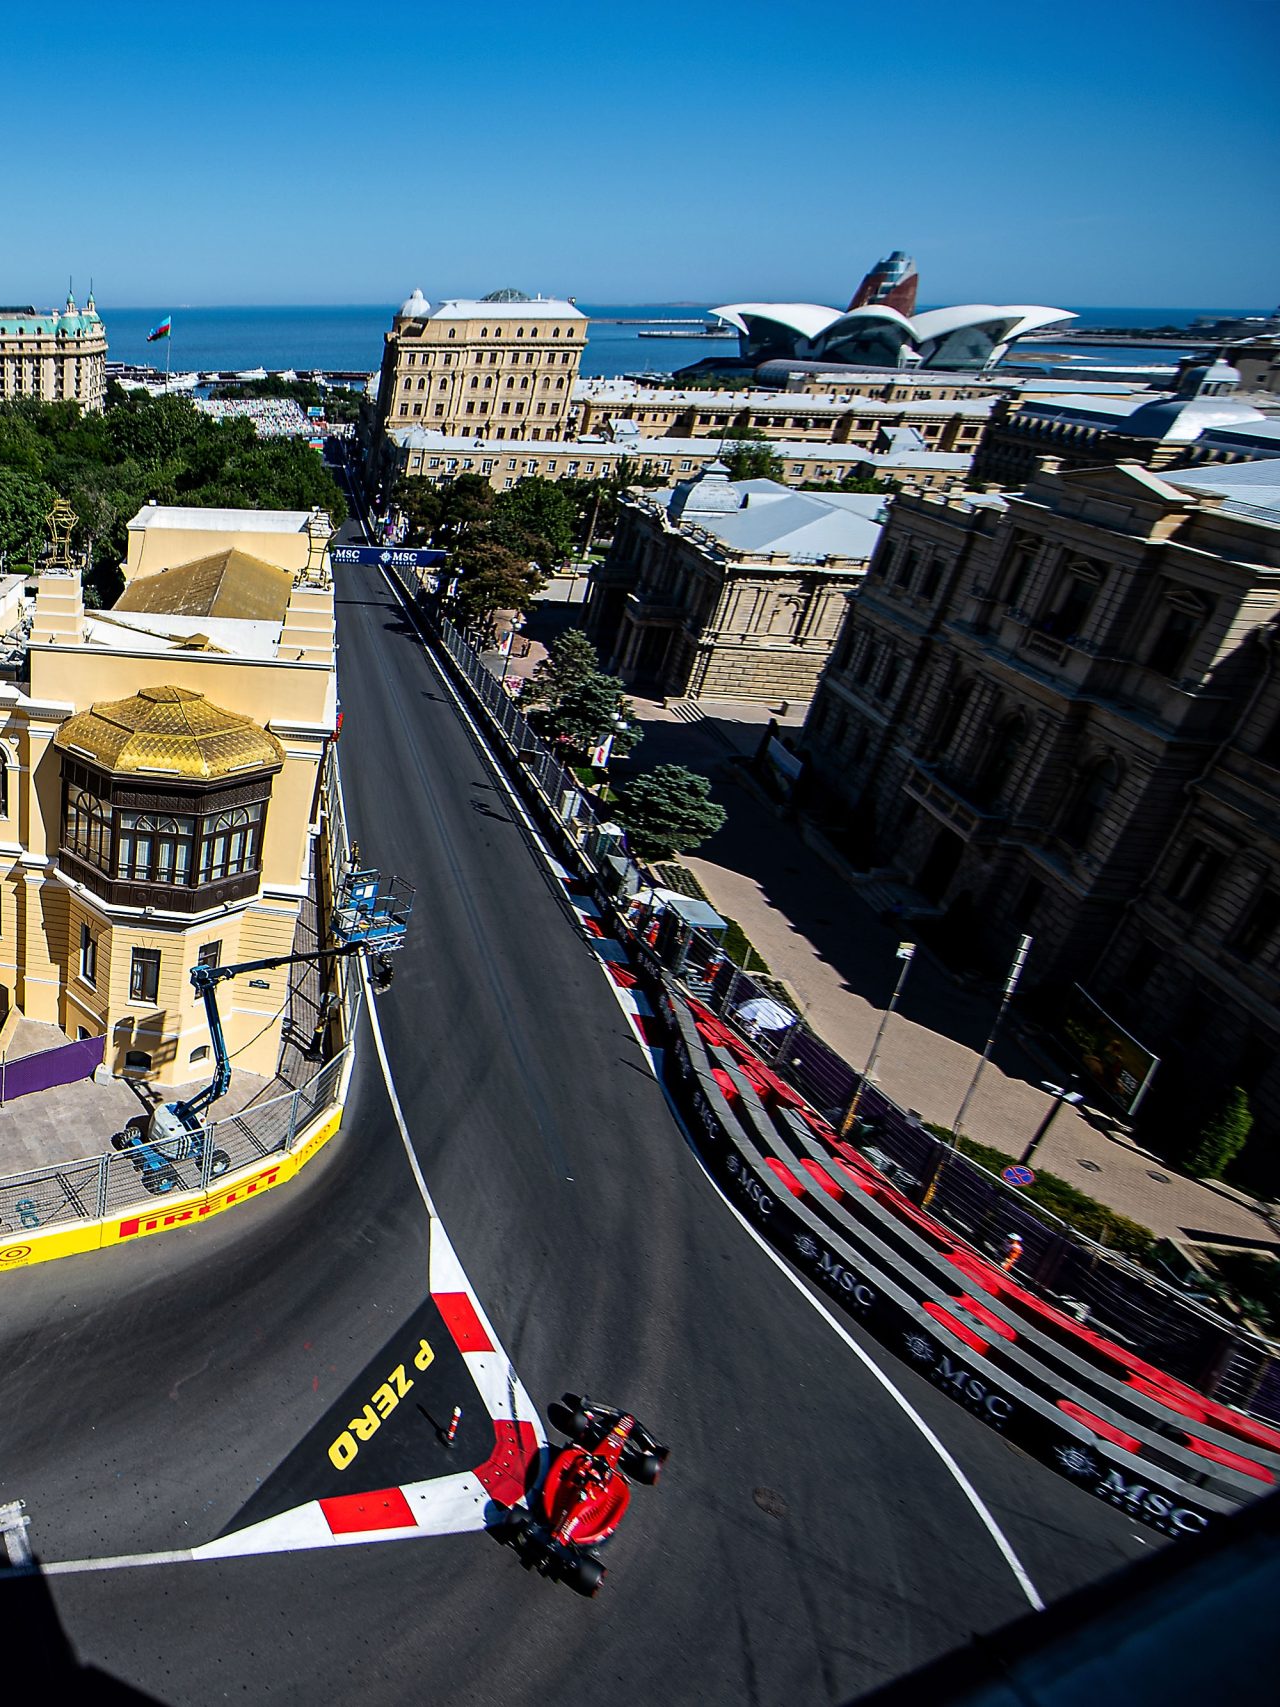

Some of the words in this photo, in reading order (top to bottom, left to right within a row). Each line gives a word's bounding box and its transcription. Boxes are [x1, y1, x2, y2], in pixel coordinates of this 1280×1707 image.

[336, 550, 360, 559] MSC
[392, 552, 418, 561] MSC
[119, 1166, 281, 1238] PIRELLI
[737, 1167, 775, 1214] MSC
[817, 1250, 876, 1306] MSC
[413, 1338, 435, 1371] P
[934, 1354, 1014, 1419] MSC
[327, 1363, 414, 1471] ZERO
[1098, 1468, 1209, 1534] MSC
